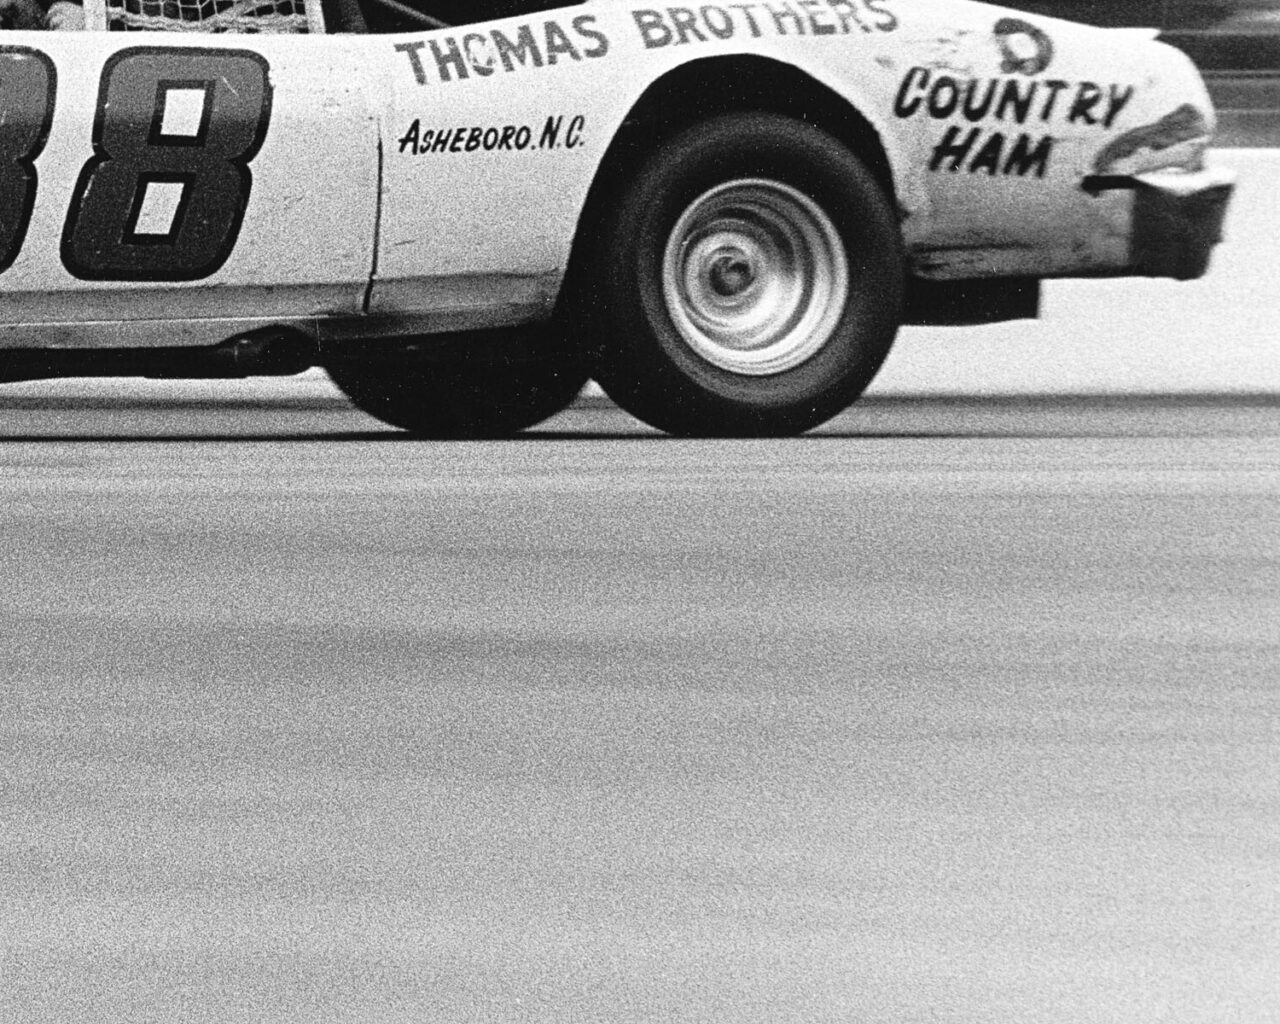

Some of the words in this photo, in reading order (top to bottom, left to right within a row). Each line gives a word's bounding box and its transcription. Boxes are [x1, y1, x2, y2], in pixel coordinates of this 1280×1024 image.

[393, 14, 609, 85] THOMAS
[893, 66, 1134, 130] COUNTRY
[927, 125, 1055, 179] HAM
